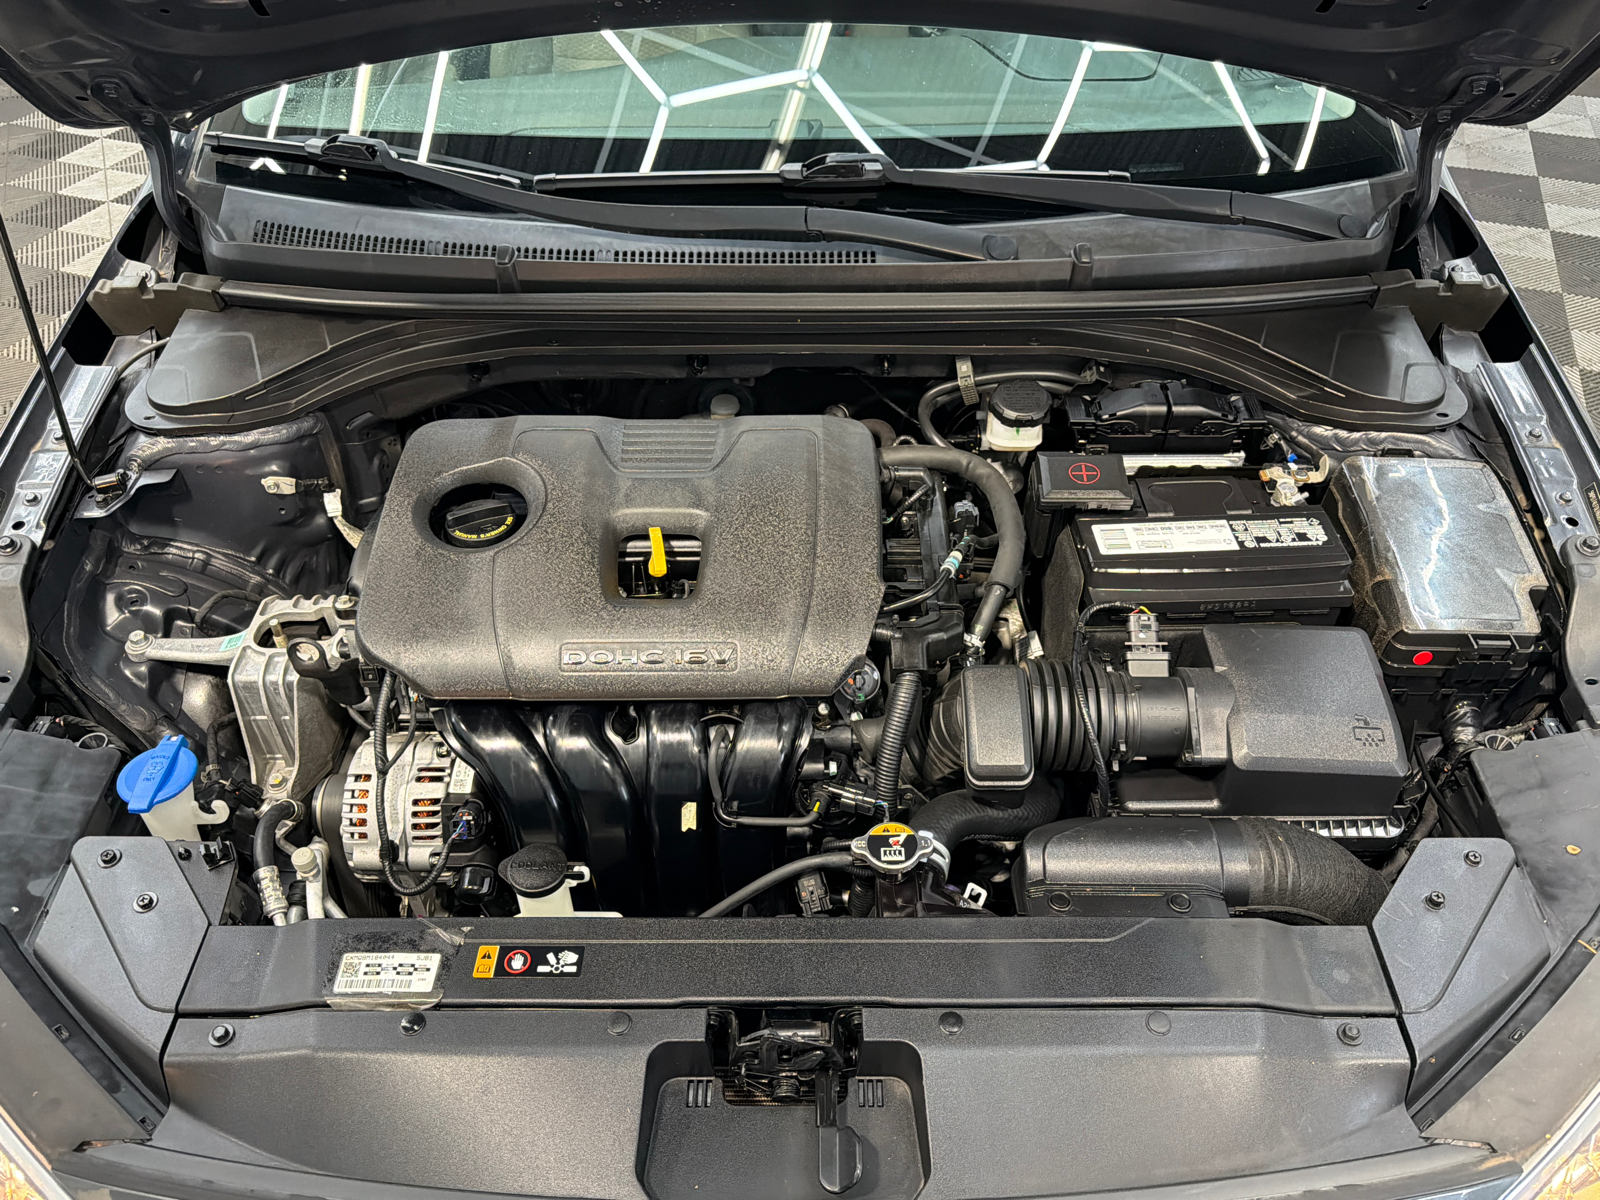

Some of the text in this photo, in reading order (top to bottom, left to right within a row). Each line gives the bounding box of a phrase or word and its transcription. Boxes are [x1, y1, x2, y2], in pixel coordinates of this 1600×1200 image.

[453, 516, 514, 539] SEE OWNER'S MANUAL
[563, 649, 734, 665] DOHC 16V
[510, 861, 565, 871] COOLANT
